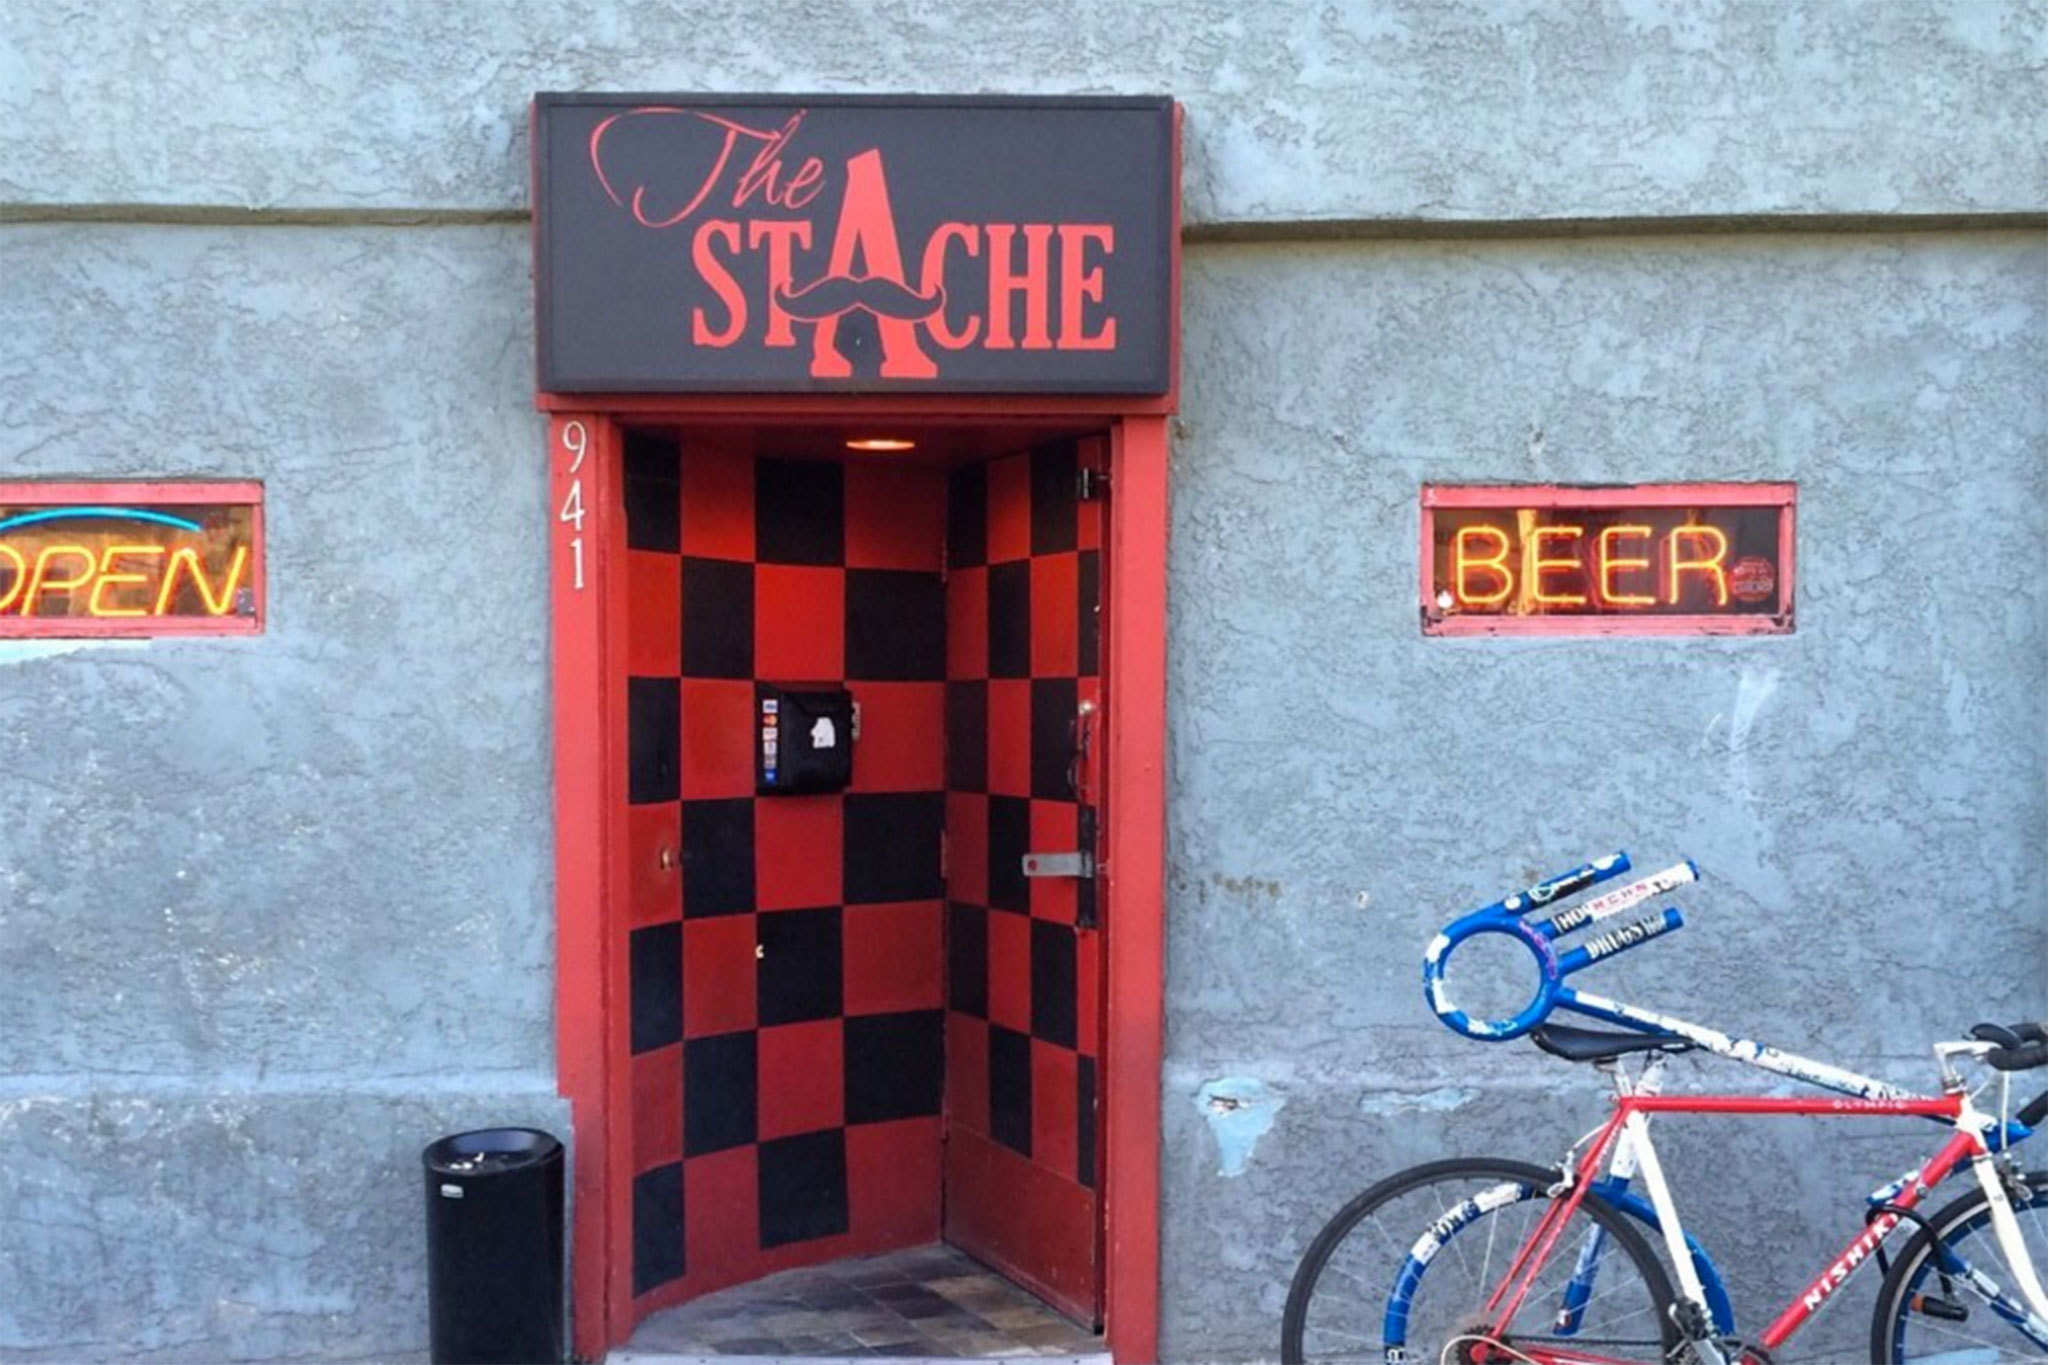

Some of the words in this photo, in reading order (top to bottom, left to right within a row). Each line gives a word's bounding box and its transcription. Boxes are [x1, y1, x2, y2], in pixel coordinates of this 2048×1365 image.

[590, 107, 826, 228] The
[691, 148, 1116, 379] STACHE
[560, 420, 587, 589] 941
[1456, 525, 1728, 606] BEER
